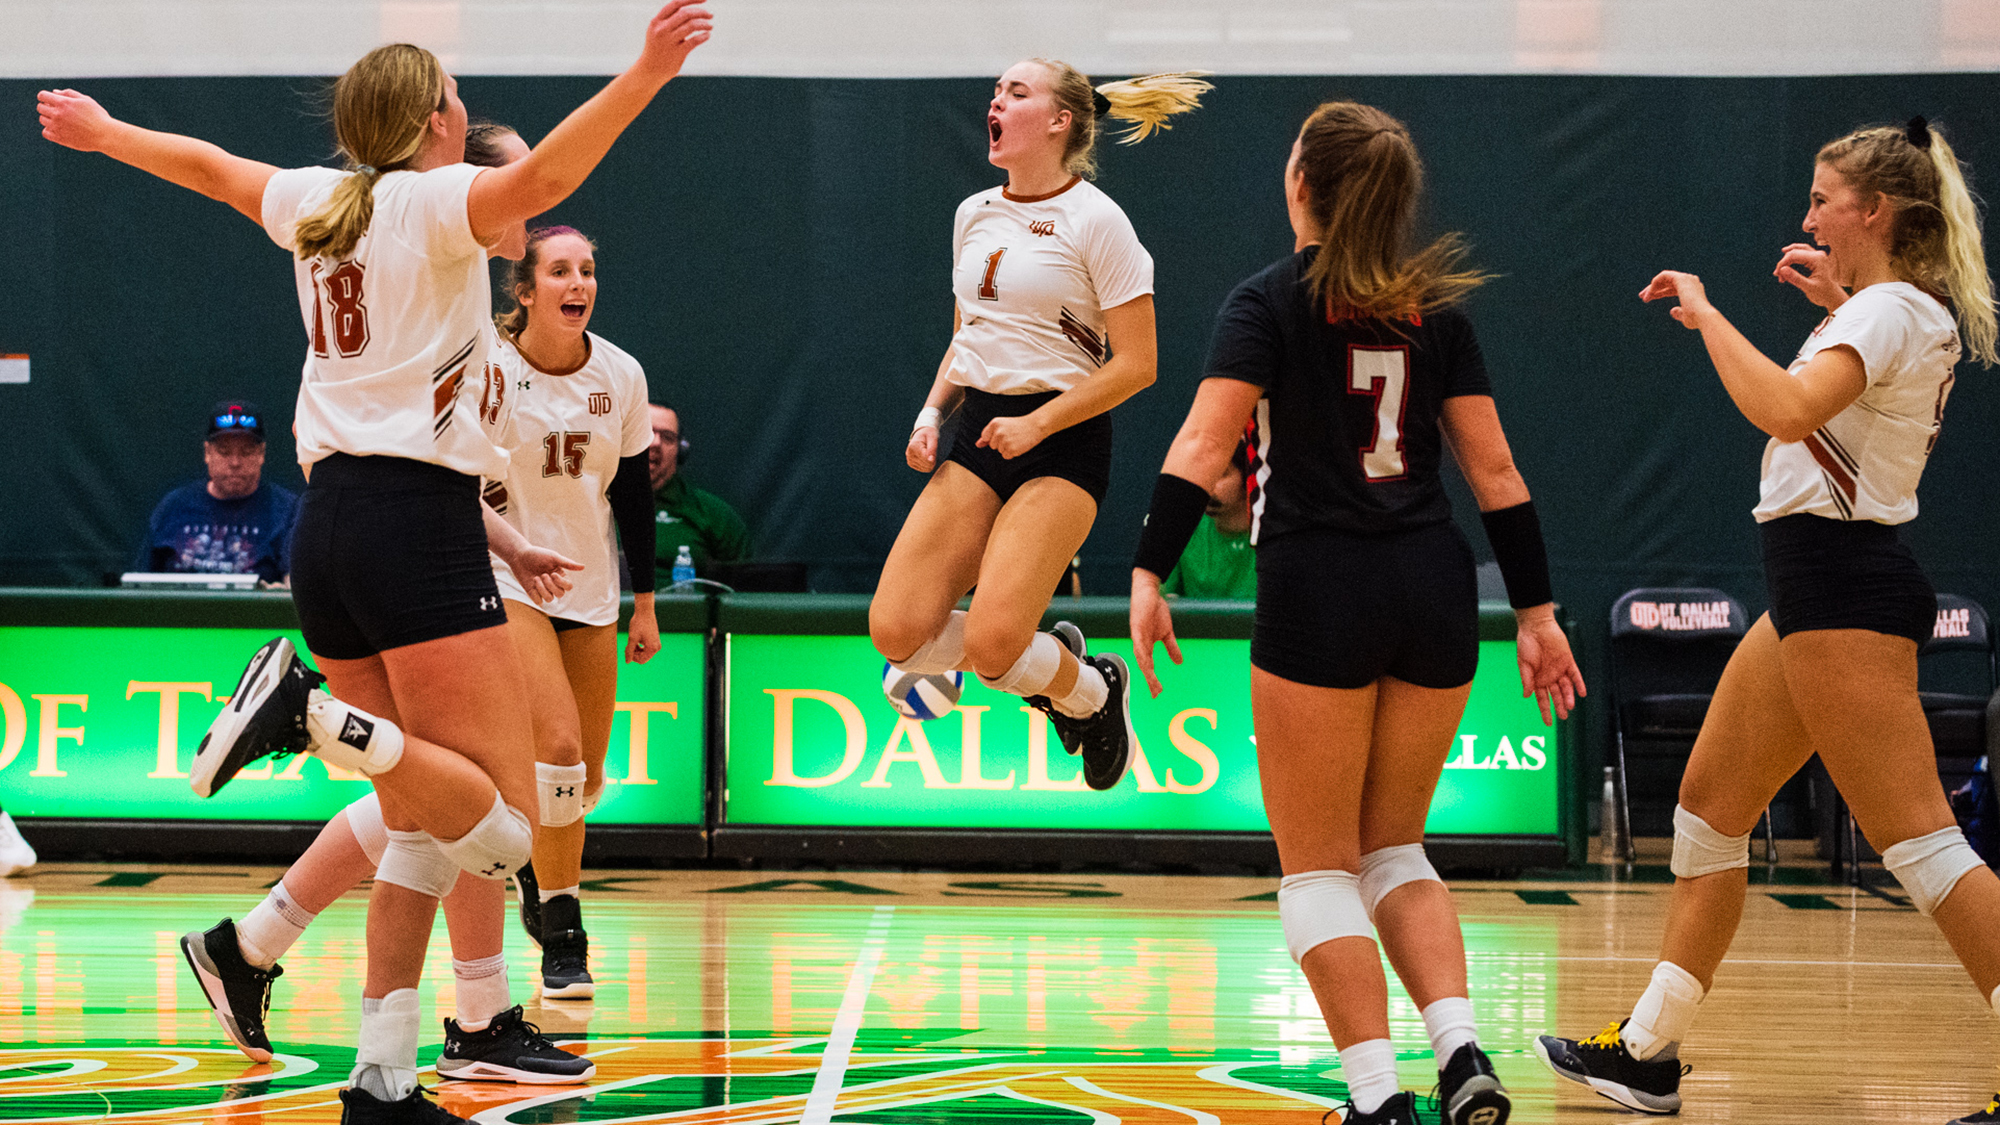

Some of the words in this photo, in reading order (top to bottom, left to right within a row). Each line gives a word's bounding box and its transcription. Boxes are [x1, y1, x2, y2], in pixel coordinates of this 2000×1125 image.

[978, 246, 1008, 301] 1
[310, 257, 371, 359] 18
[588, 392, 612, 417] UTD
[1347, 343, 1410, 483] 7
[542, 431, 591, 479] 15
[1660, 603, 1676, 616] UT
[1680, 601, 1730, 616] DALLAS
[1661, 614, 1731, 630] VOLLEYBALL
[1936, 608, 1970, 623] LLAS
[605, 701, 678, 785] T
[1443, 735, 1547, 770] LAS
